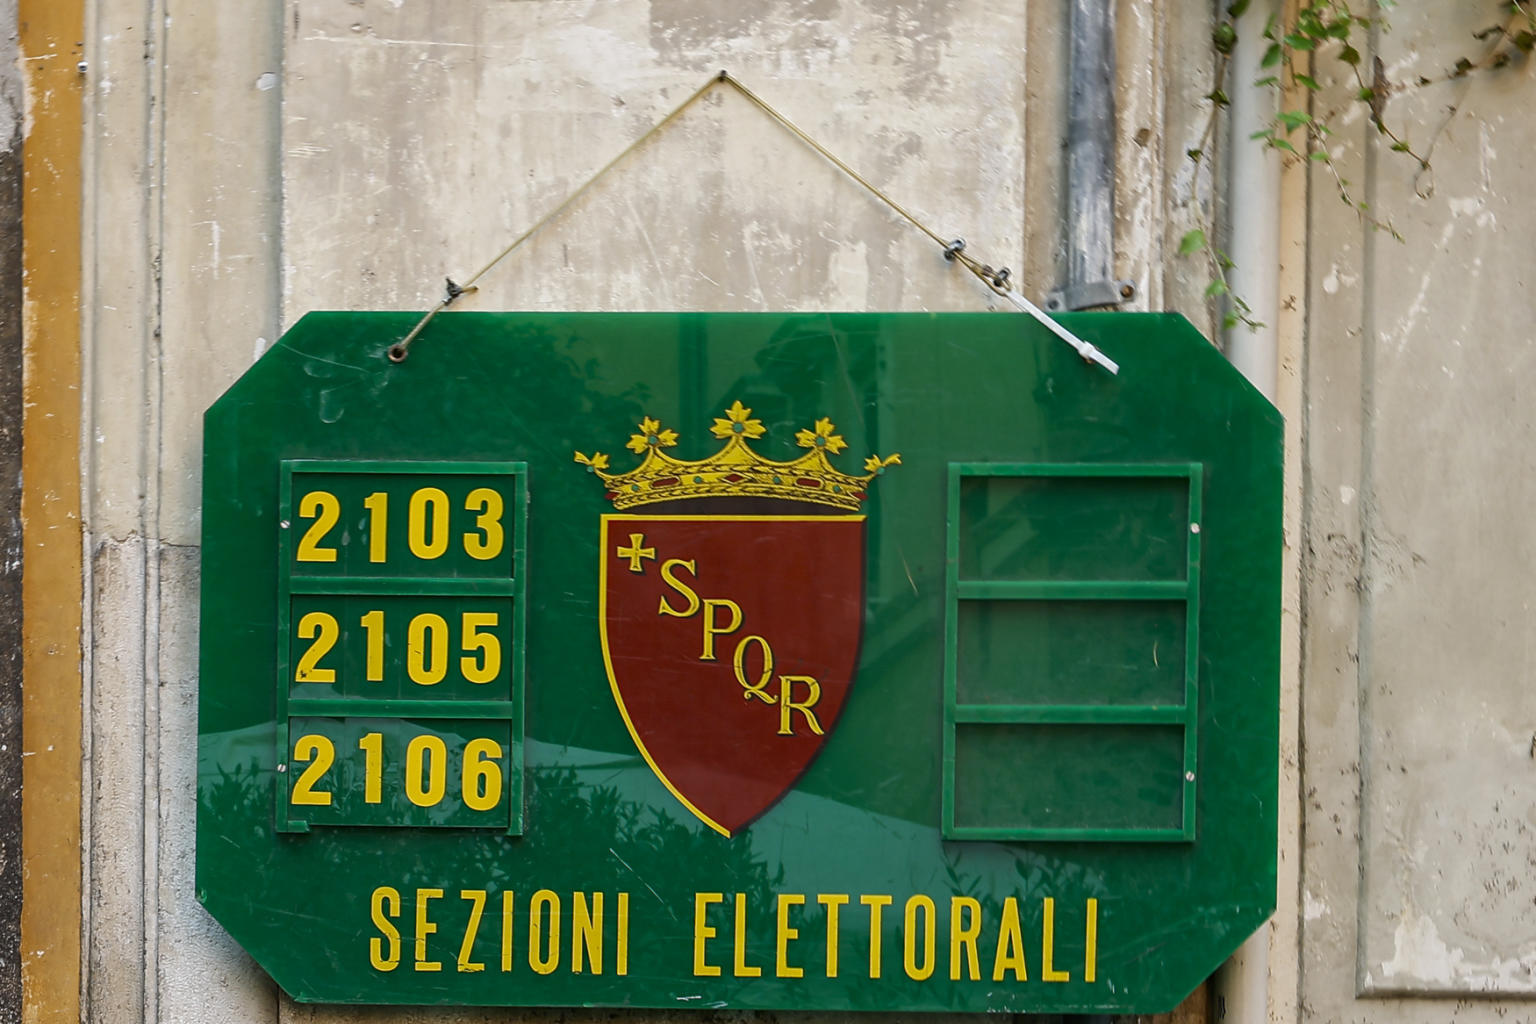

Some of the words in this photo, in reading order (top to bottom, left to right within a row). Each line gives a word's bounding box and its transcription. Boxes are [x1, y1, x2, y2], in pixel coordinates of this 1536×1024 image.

[296, 487, 505, 563] 2103
[295, 610, 502, 686] 2105
[658, 558, 825, 736] SPQR
[291, 733, 504, 812] 2106
[369, 886, 629, 977] SEZIONI
[693, 892, 1098, 983] ELETTORALI
